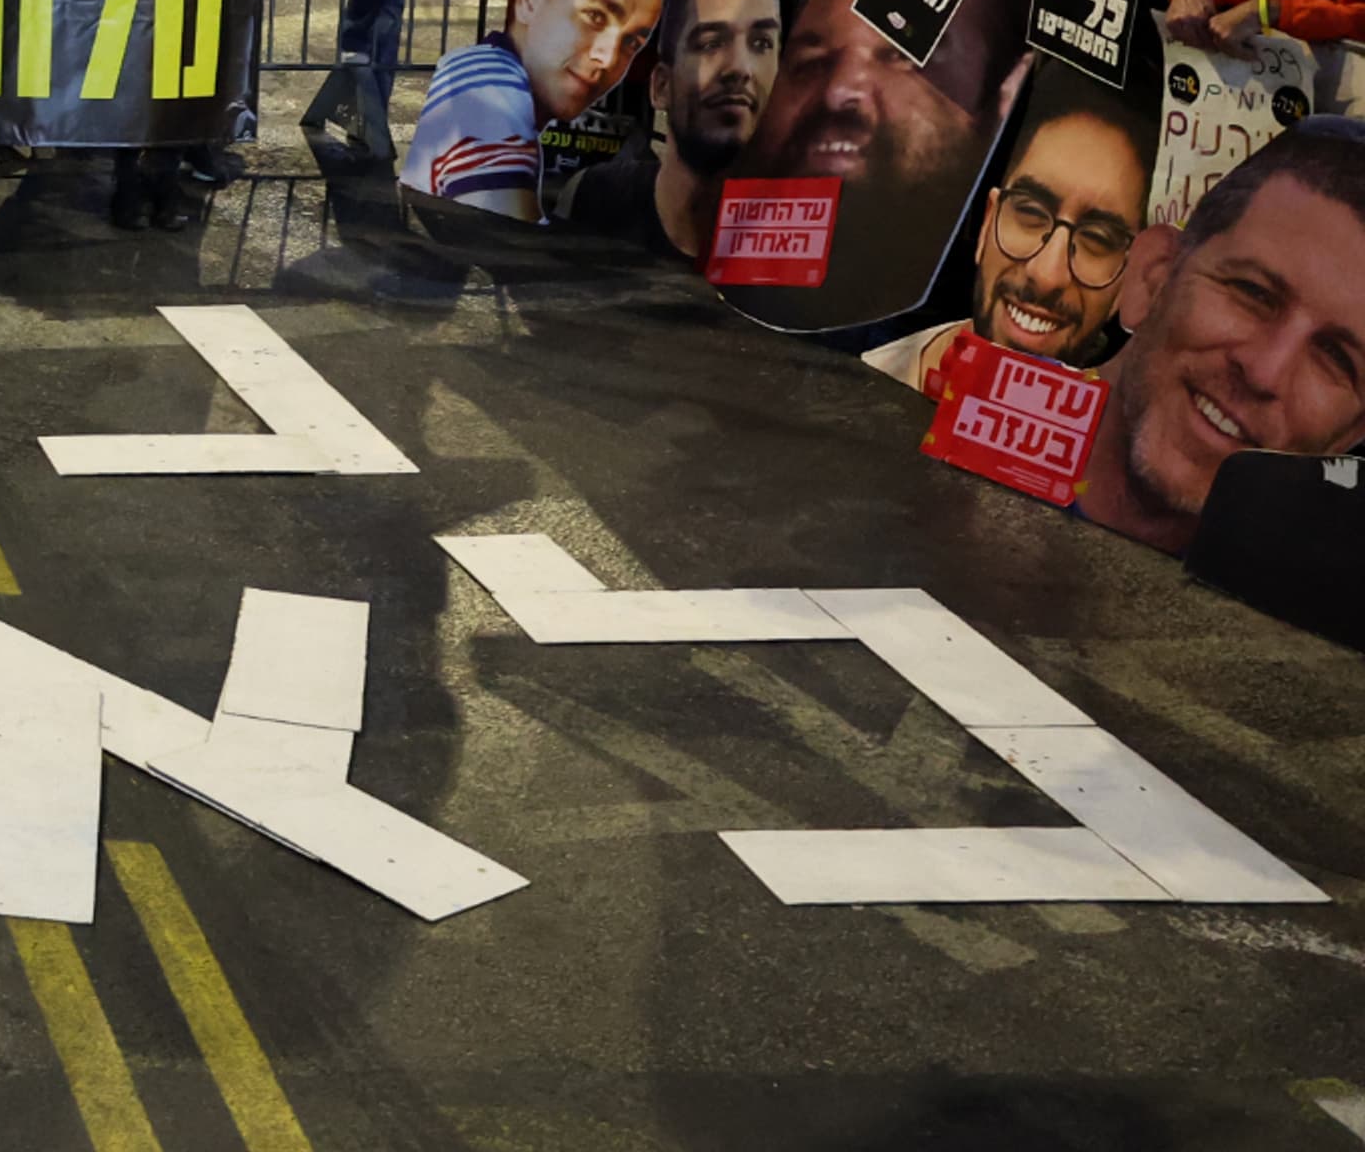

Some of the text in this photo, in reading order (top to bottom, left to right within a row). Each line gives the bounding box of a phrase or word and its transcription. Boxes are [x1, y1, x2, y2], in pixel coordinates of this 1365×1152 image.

[1037, 7, 1120, 67] החטופים!
[727, 201, 828, 224] עד החטוף
[729, 231, 812, 255] האחרון
[995, 362, 1095, 421] עדיין
[957, 405, 1077, 471] בעזה.
